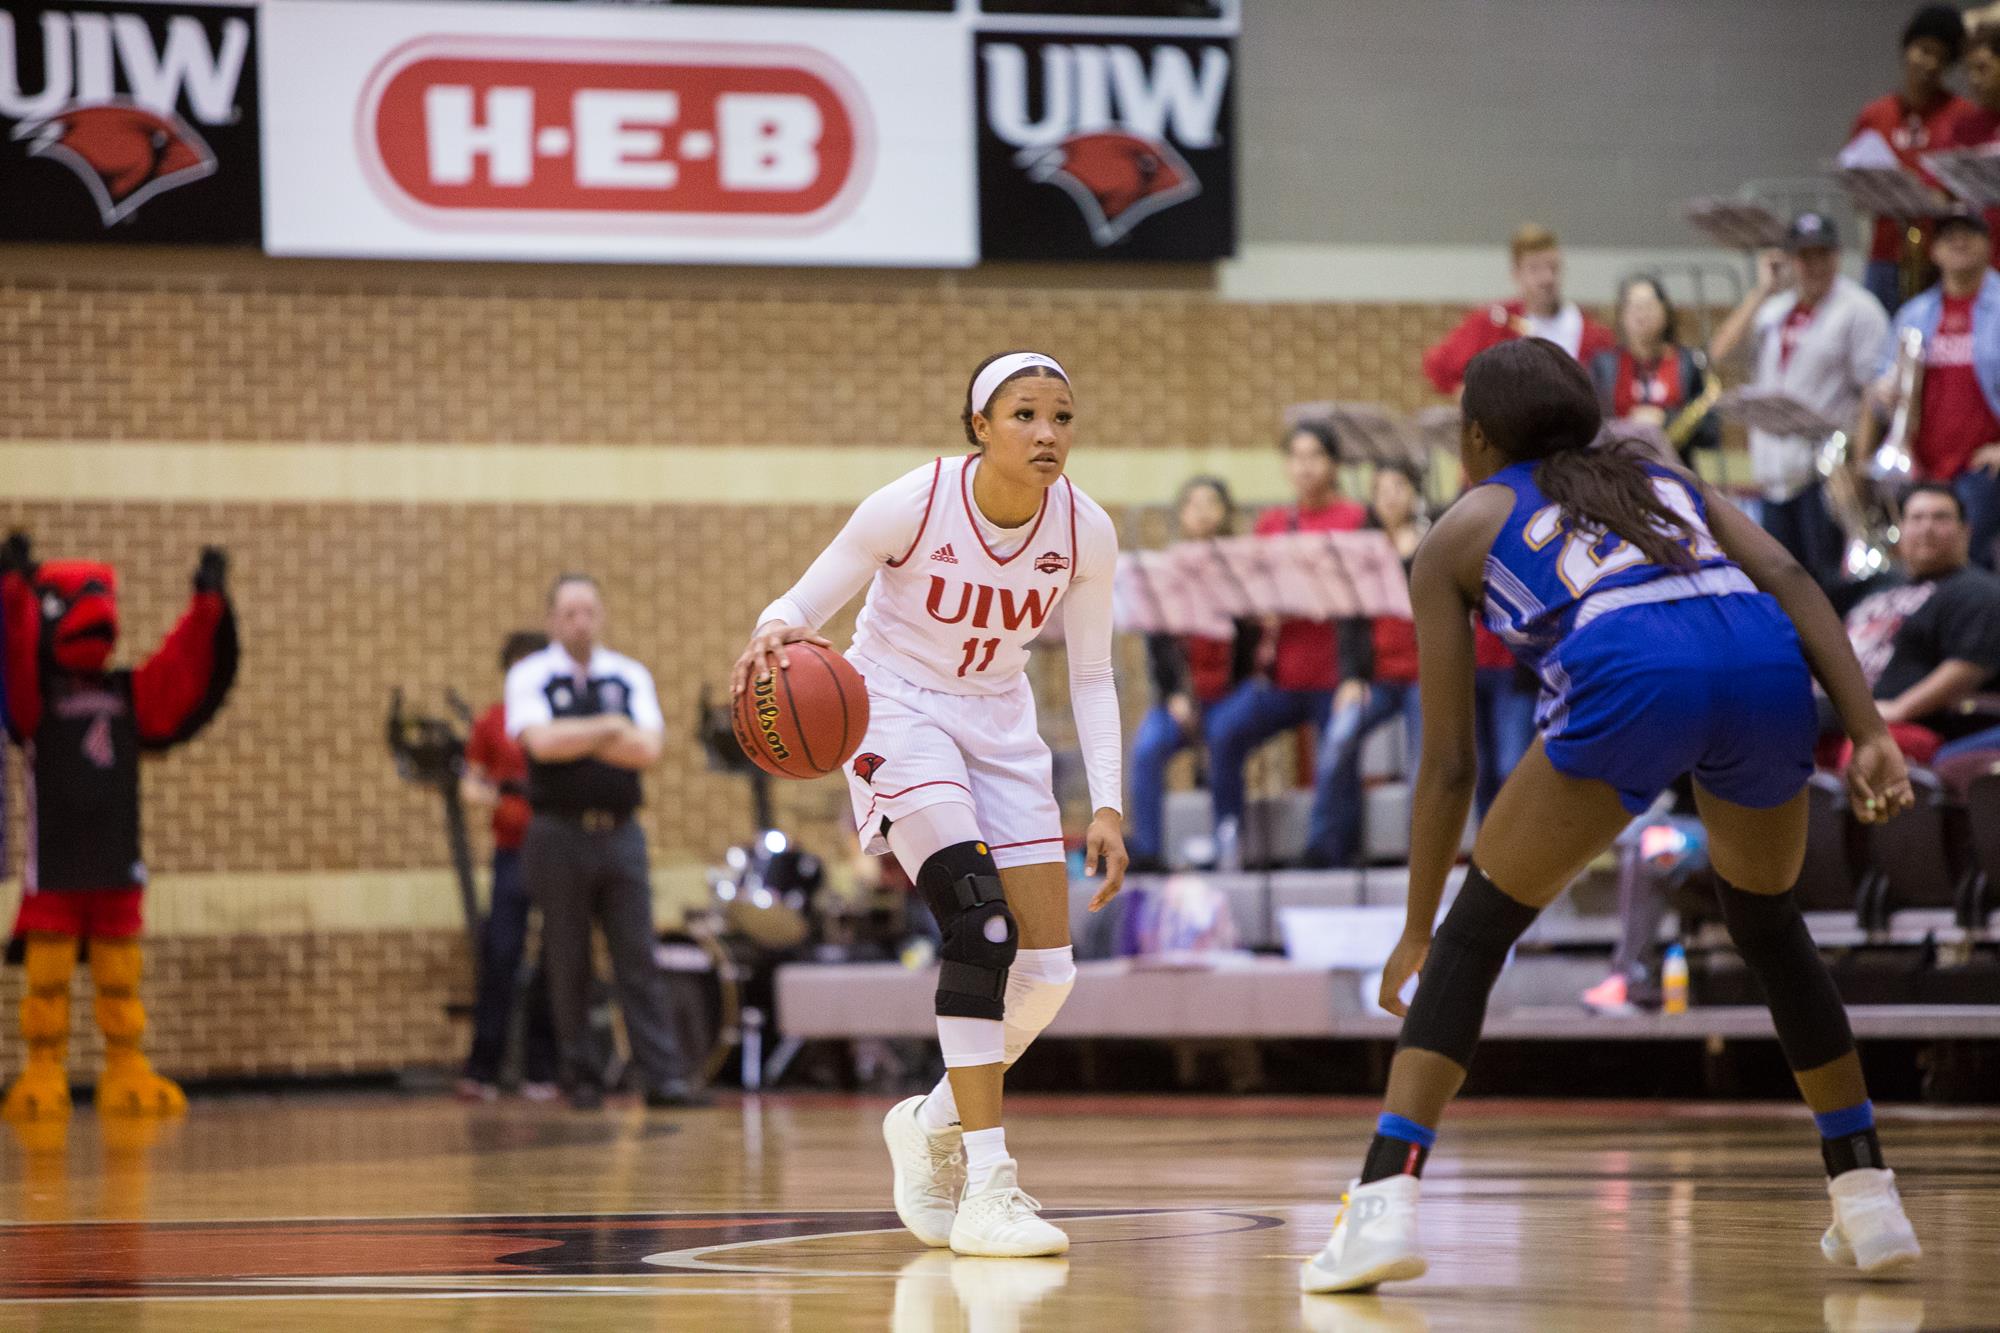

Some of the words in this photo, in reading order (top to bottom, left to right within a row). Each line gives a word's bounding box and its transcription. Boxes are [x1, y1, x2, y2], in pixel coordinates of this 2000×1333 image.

[0, 8, 249, 125] UIW
[982, 43, 1230, 149] UIW
[926, 574, 1058, 630] UIW
[957, 637, 1000, 677] 11
[754, 666, 790, 761] Wilson
